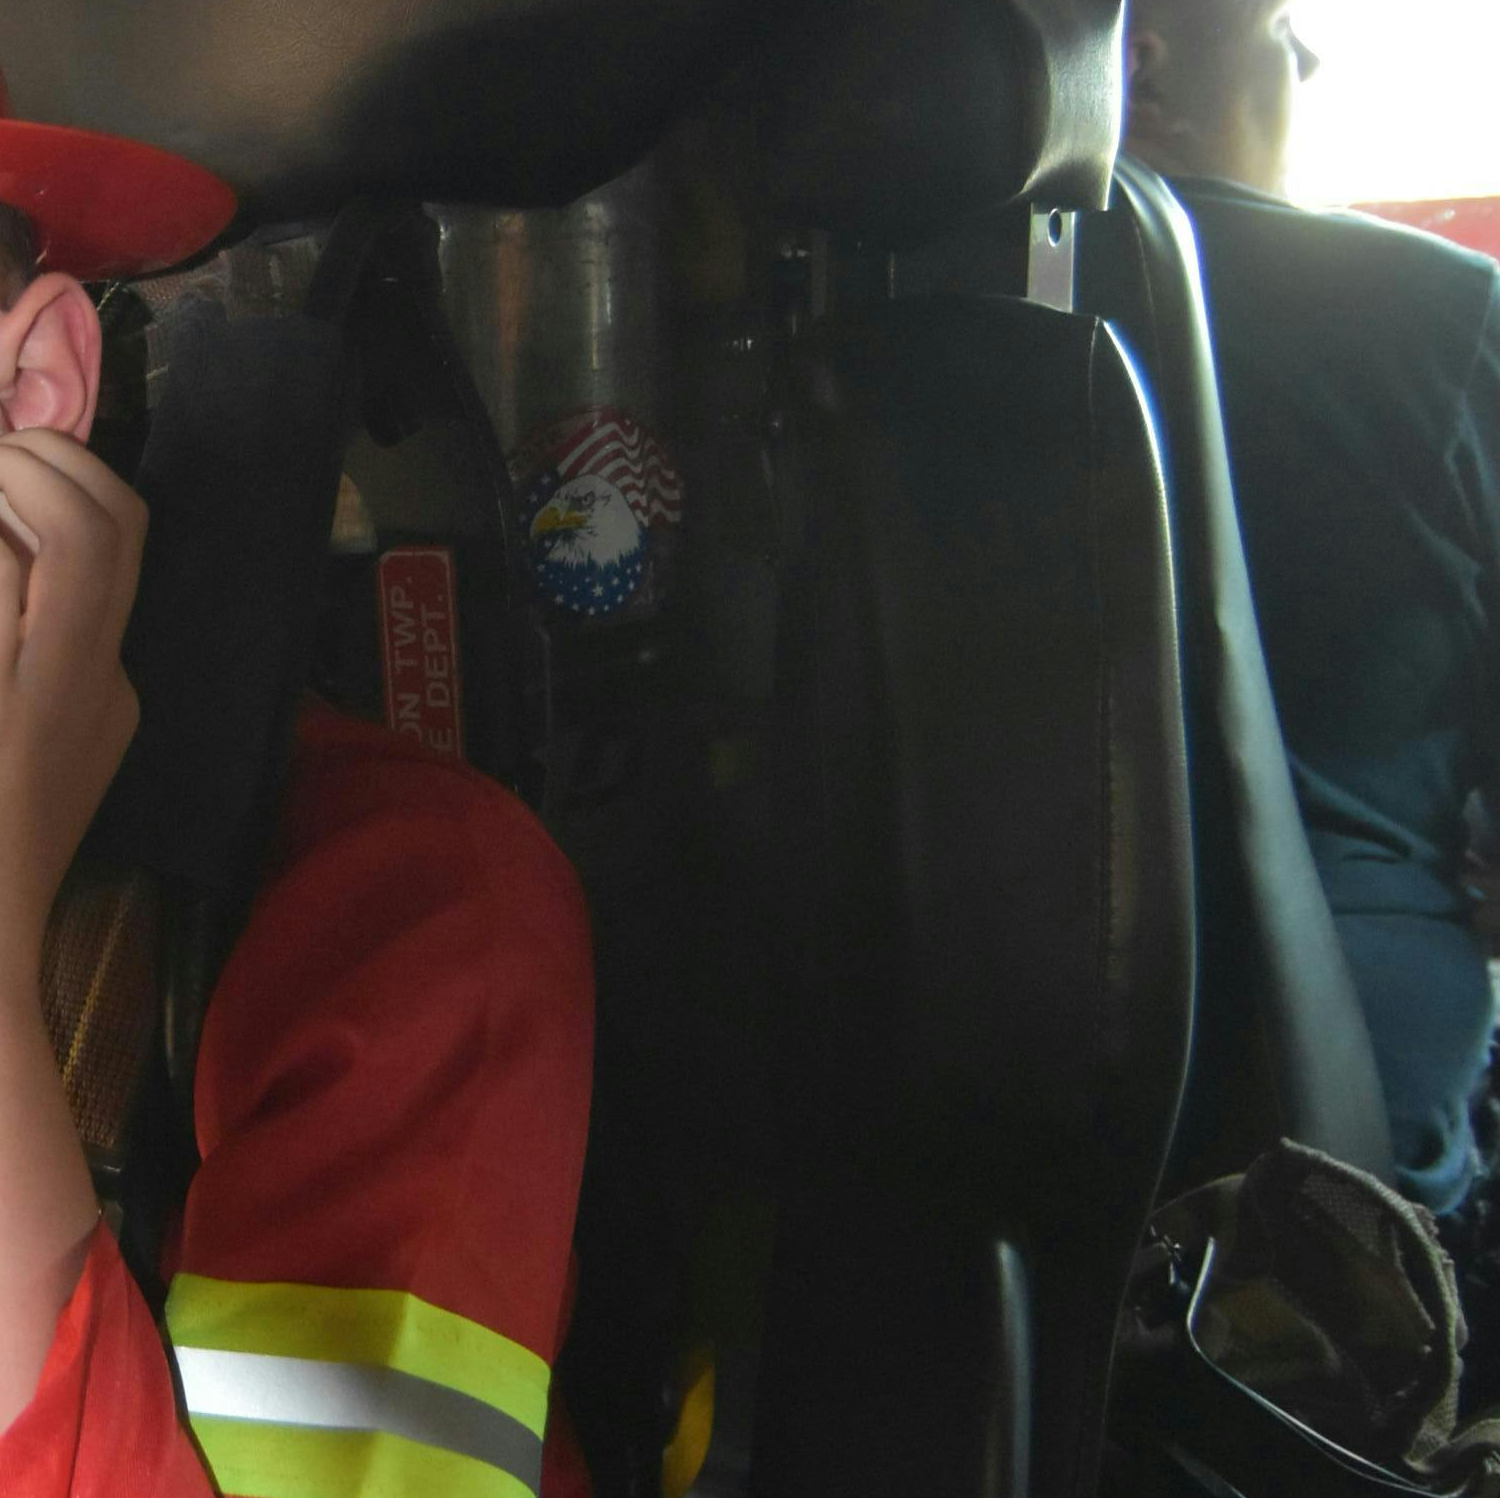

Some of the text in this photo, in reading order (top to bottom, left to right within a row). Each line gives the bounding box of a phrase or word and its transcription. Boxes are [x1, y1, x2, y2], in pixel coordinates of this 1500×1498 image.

[390, 575, 418, 675] TWP.
[421, 593, 453, 752] E DEPT.
